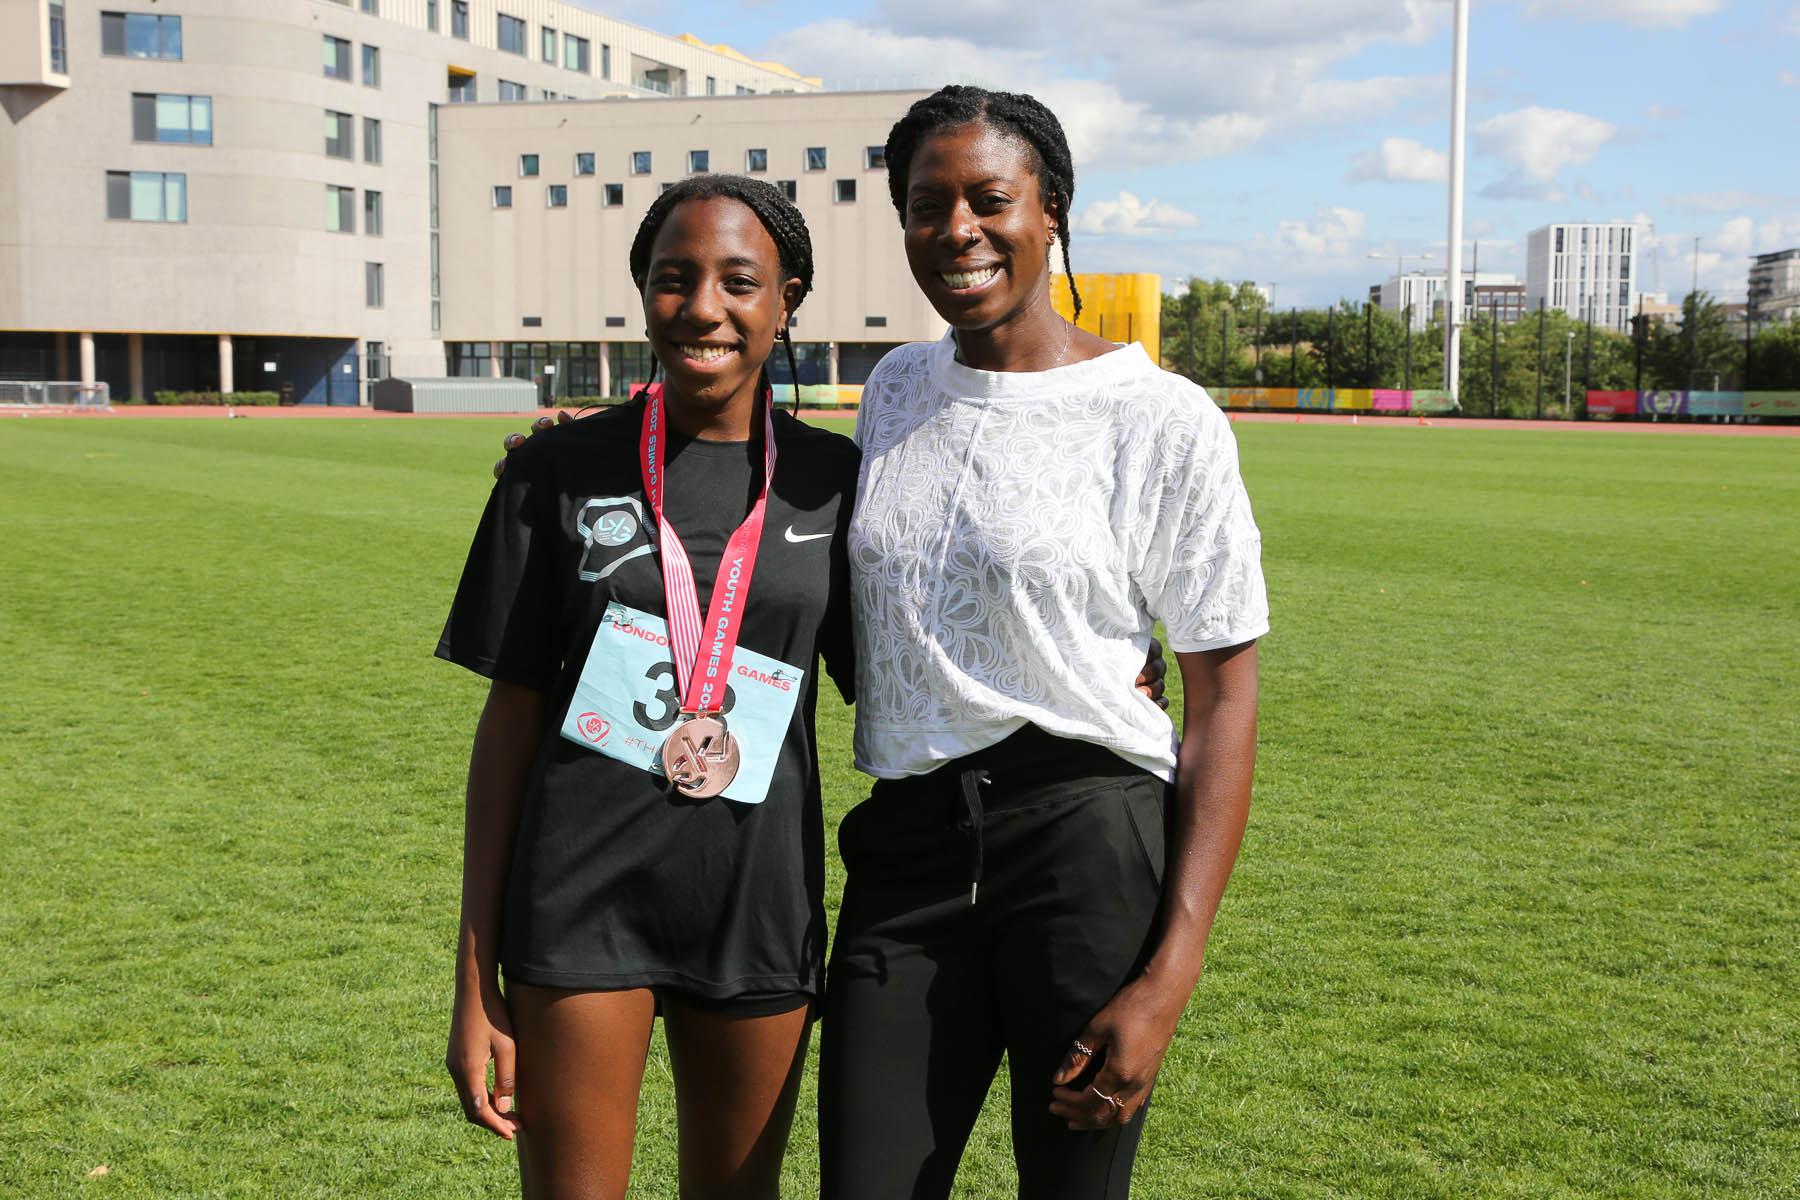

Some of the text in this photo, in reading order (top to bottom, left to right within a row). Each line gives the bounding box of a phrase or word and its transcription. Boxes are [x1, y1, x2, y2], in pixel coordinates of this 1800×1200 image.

[650, 398, 659, 432] 2023
[648, 435, 658, 485] GAMES
[722, 557, 744, 612] YOUTH
[613, 621, 791, 691] LONDO GAMES
[707, 617, 729, 678] GAMES
